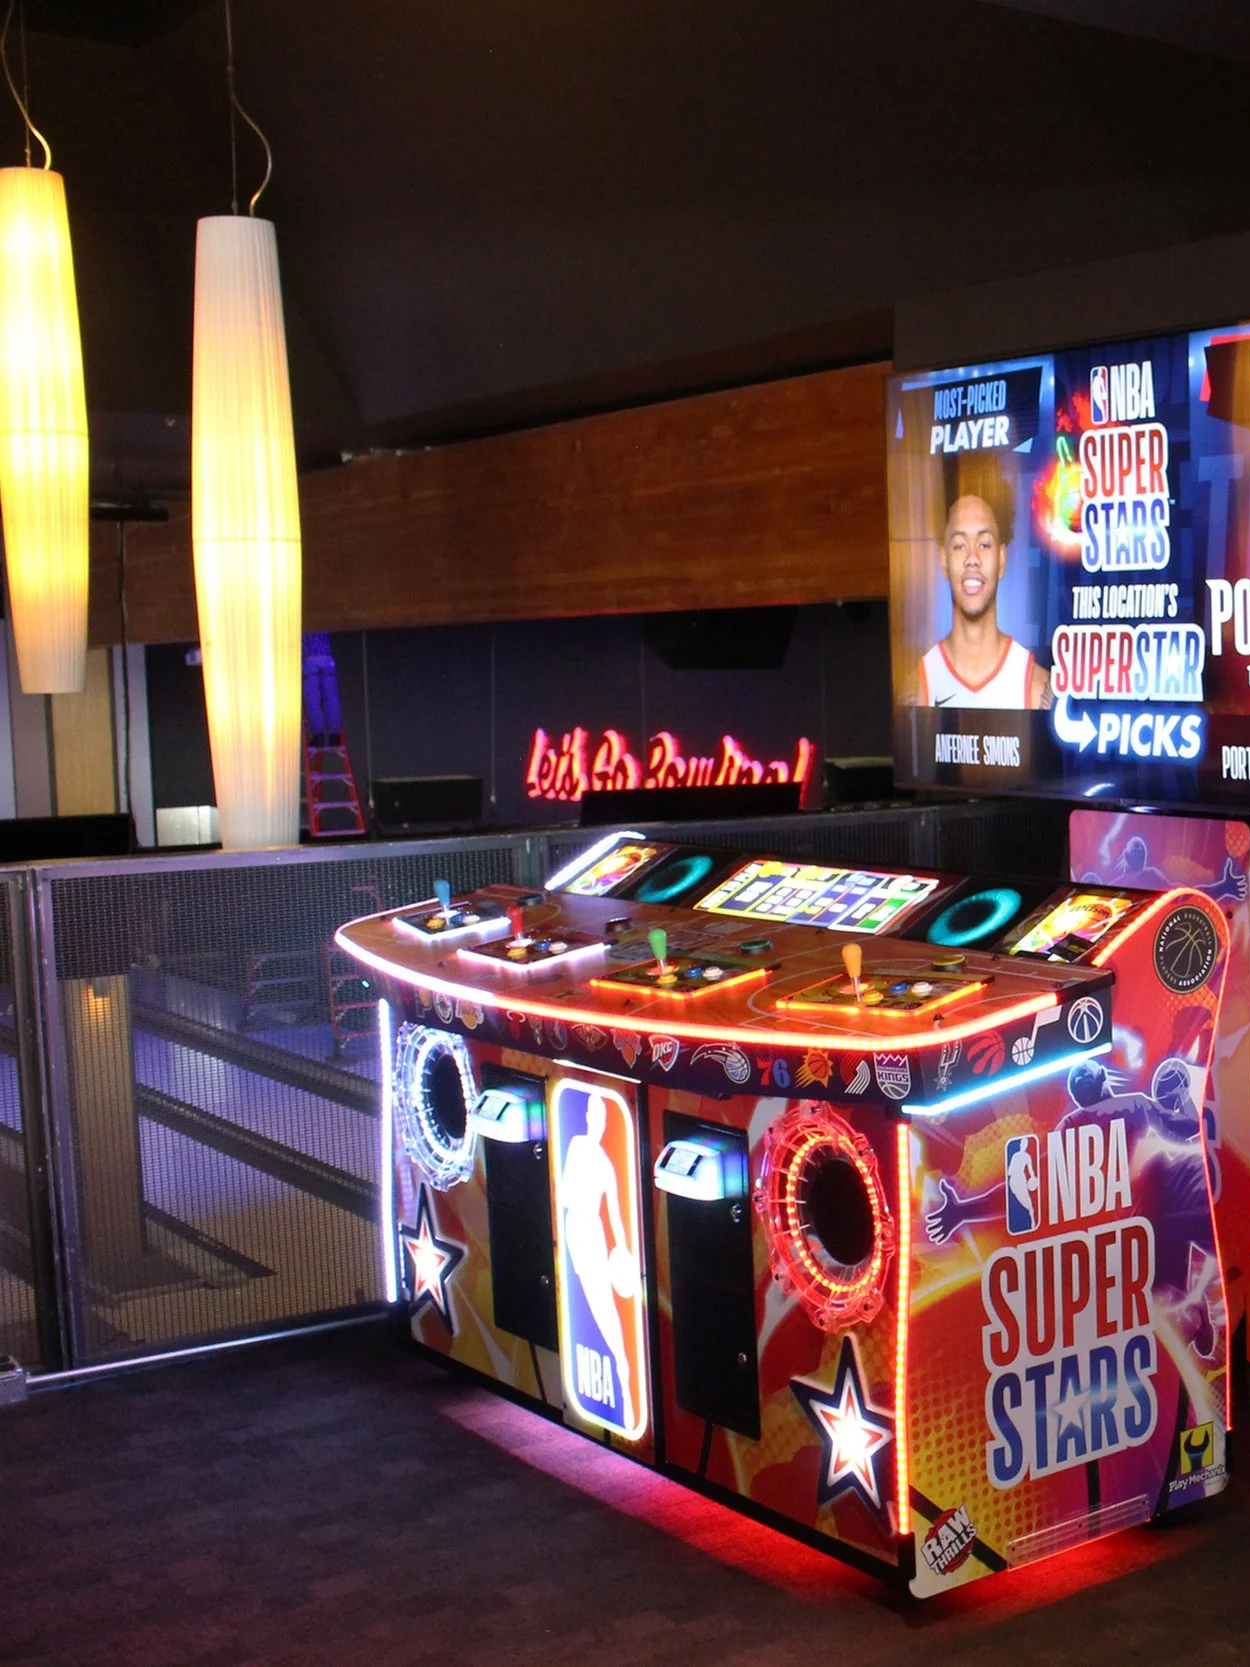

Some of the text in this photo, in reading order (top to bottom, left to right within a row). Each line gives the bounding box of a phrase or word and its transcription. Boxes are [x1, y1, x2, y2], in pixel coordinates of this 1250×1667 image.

[933, 380, 1007, 421] MOST-PICKED
[1110, 360, 1156, 422] NBA
[930, 416, 1010, 455] PLAYER
[1083, 428, 1166, 500] SUPER
[1084, 498, 1166, 567] STARS
[1072, 584, 1178, 620] THIS LOCATION'S
[1055, 628, 1201, 695] SUPERSTAR
[935, 733, 1020, 768] ANFERNEE SIMONS
[1096, 712, 1202, 759] PICKS
[1159, 915, 1181, 953] NATIONAL
[1178, 948, 1213, 987] ASSOCIATION
[652, 1041, 673, 1062] OKC
[756, 1057, 791, 1089] 76
[877, 1071, 909, 1083] KINGS
[1046, 1117, 1133, 1227] NBA
[988, 1224, 1151, 1362] SUPER
[576, 1343, 616, 1410] NBA
[991, 1339, 1153, 1481] STARS
[1168, 1465, 1226, 1493] Play Mechanix
[920, 1504, 972, 1567] RAW
[930, 1523, 977, 1576] THRILLS
